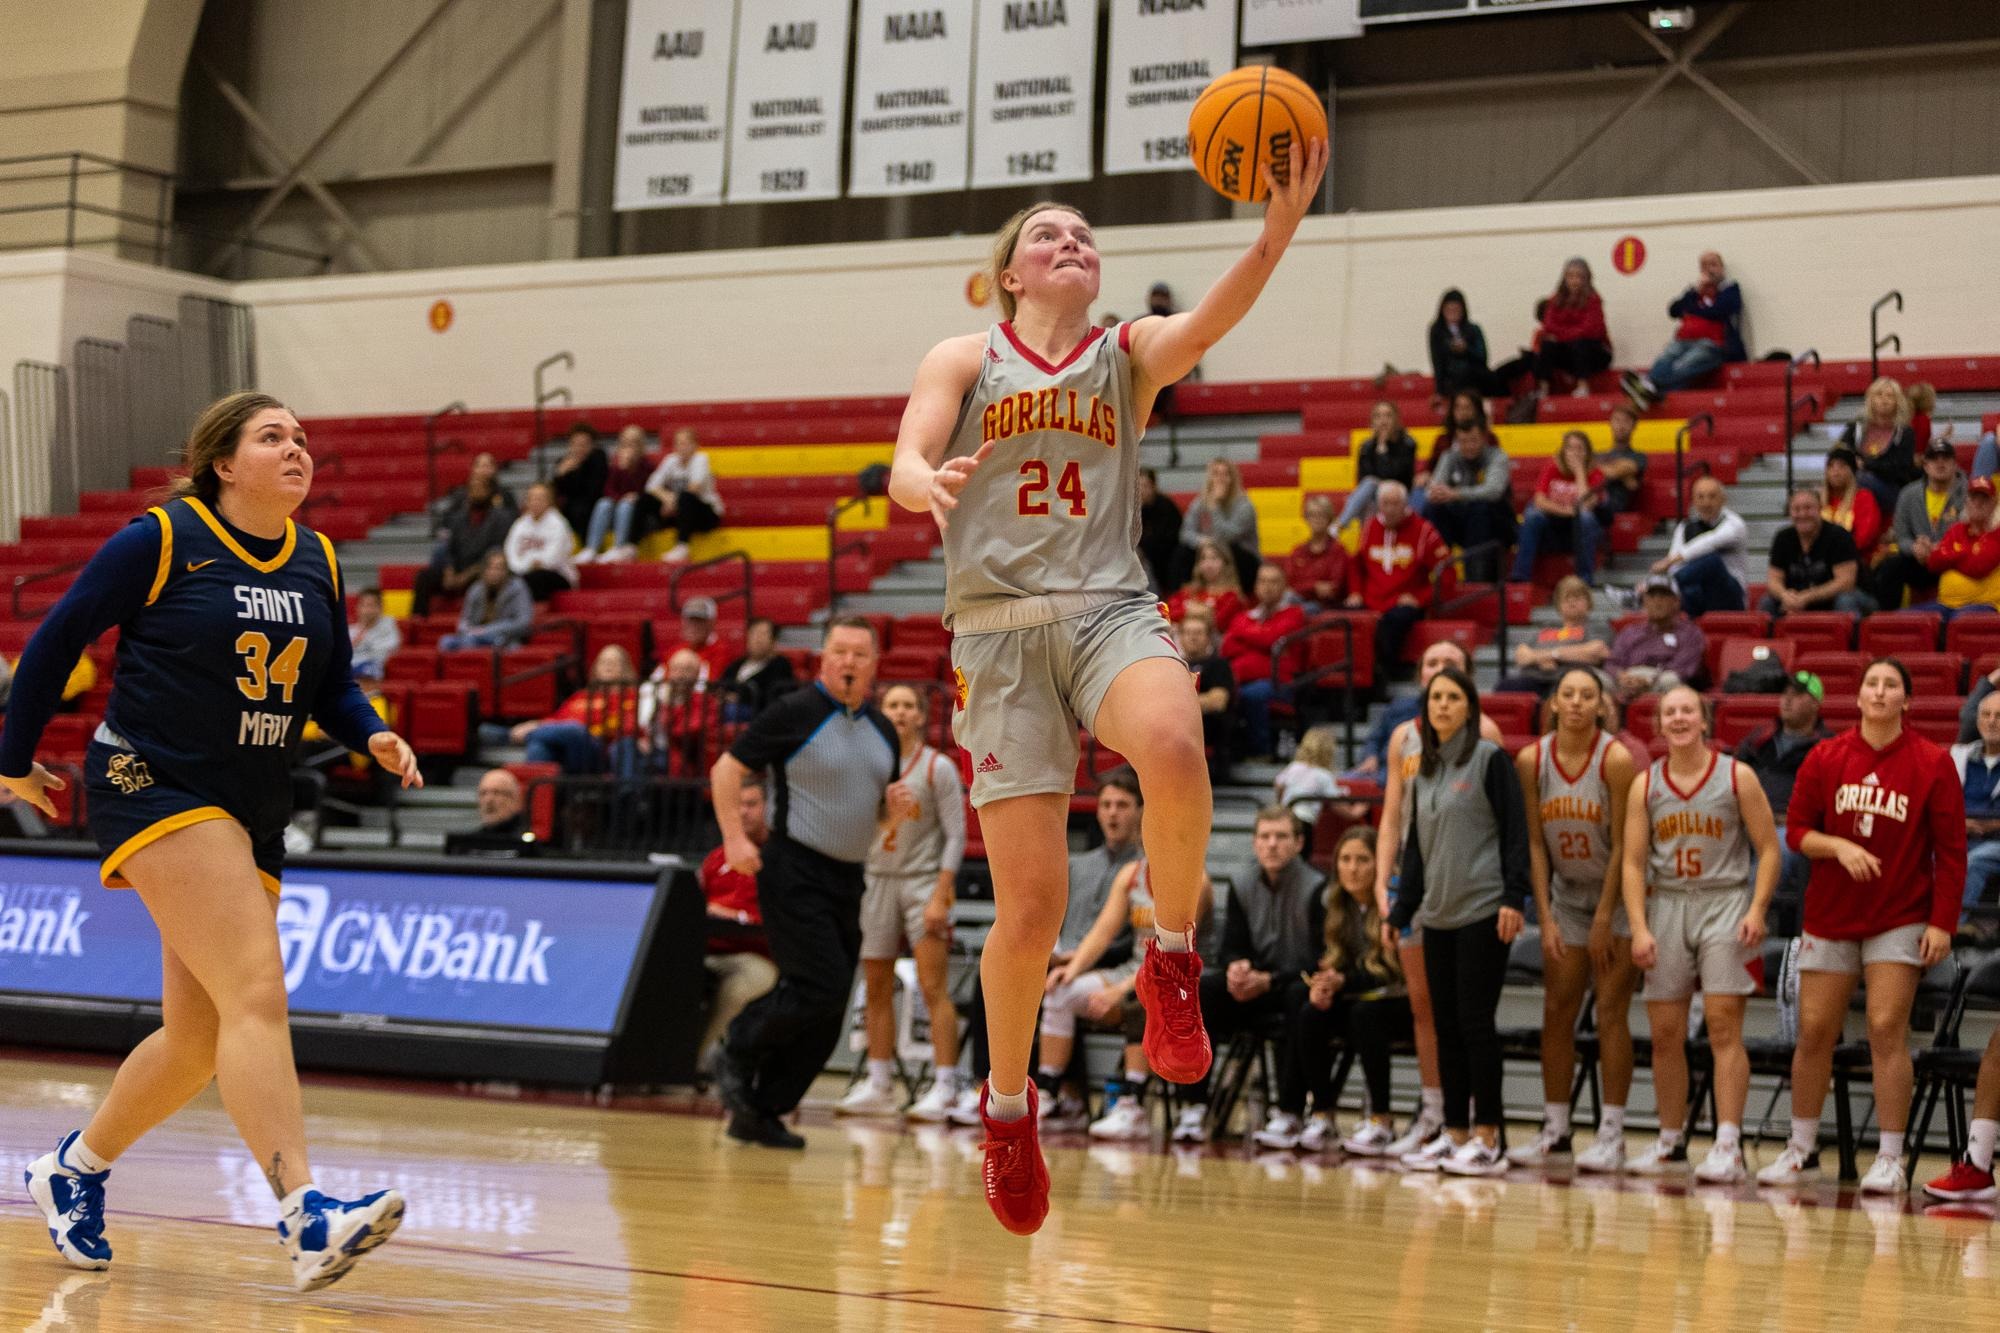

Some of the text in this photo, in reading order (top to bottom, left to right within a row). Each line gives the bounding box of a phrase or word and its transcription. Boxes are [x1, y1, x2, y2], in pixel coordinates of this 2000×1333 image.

[884, 10, 946, 42] NAIA
[1003, 0, 1067, 32] NAIA
[994, 76, 1072, 100] NATIONAL
[1128, 60, 1210, 85] NATIONAL
[875, 88, 950, 110] NATIONAL
[1007, 150, 1056, 175] 1942
[982, 387, 1117, 448] GORILLAS
[1017, 458, 1088, 518] 24
[234, 585, 304, 624] SAINT
[235, 631, 308, 703] 34
[976, 763, 1004, 774] adidas
[1557, 830, 1592, 859] 23
[1675, 847, 1703, 878] 15
[0, 893, 92, 957] ank
